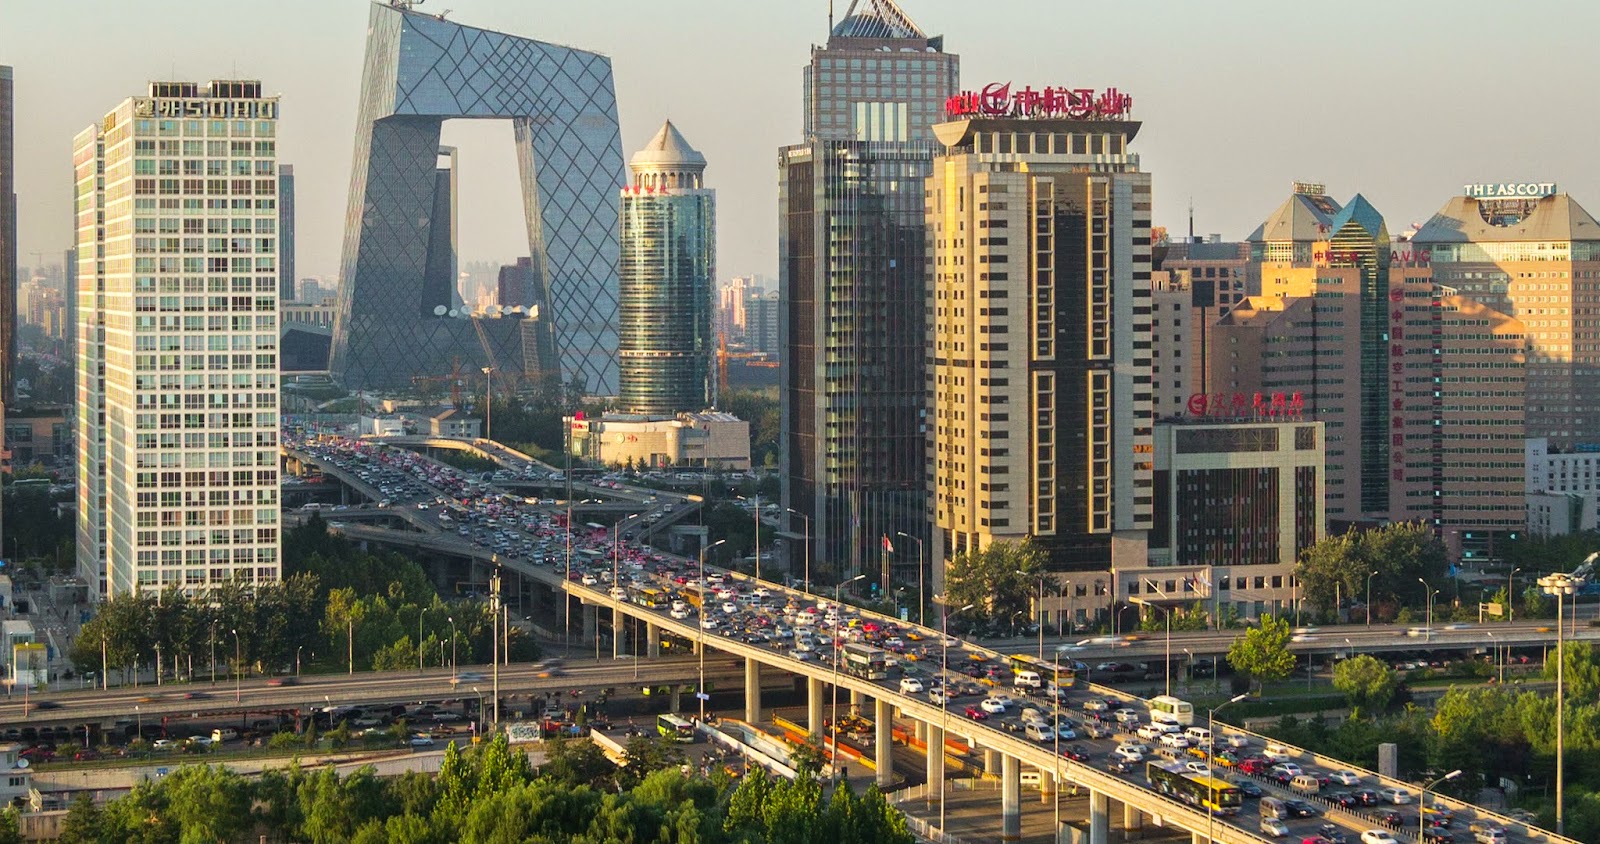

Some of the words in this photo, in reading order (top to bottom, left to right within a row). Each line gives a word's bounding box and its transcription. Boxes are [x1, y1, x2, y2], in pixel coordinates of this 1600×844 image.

[1015, 85, 1124, 117] 中航工业
[1464, 184, 1495, 196] THE
[1497, 183, 1555, 196] ASCOTT
[1390, 250, 1431, 262] AVIC
